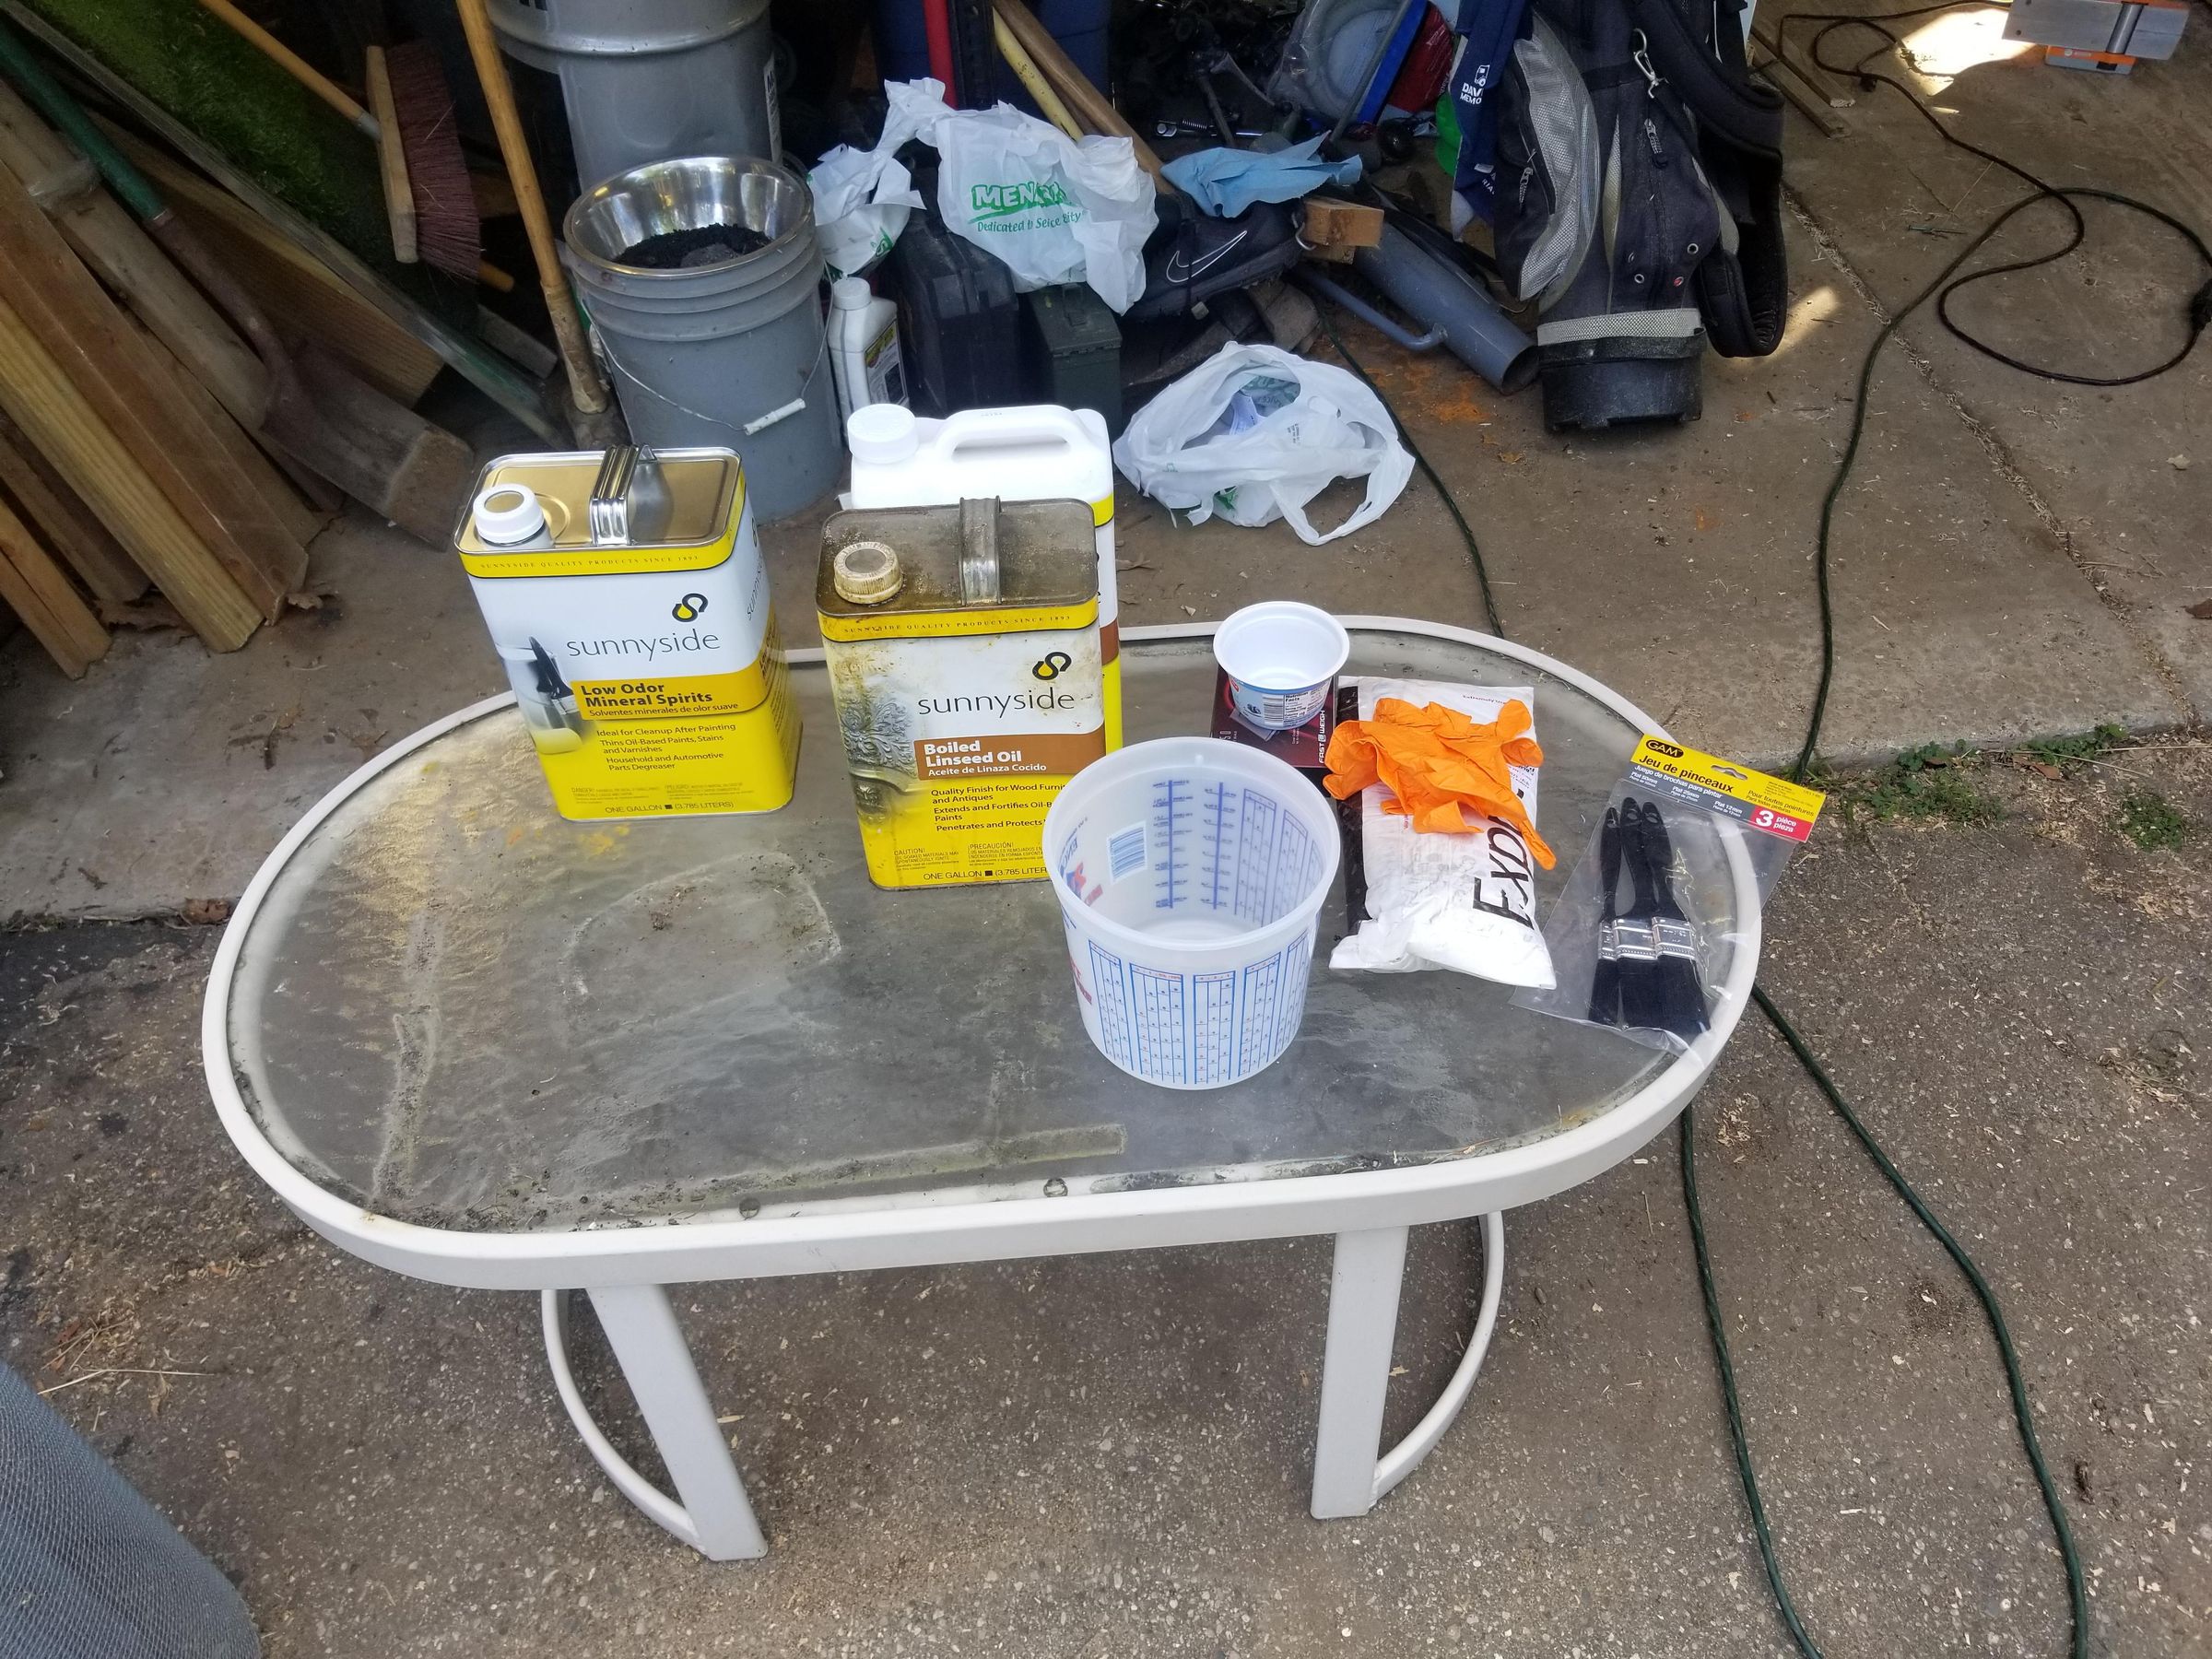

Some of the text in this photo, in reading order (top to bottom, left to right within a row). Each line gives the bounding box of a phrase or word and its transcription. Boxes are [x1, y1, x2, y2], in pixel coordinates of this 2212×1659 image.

[956, 619, 1009, 628] PRODUCTS
[567, 629, 721, 662] sunnyside
[581, 683, 665, 696] Low Odor
[585, 691, 712, 708] Mineral Spirits
[918, 687, 1075, 719] sunnyside
[589, 702, 738, 717] Solventes minerales de olor suave
[635, 727, 673, 736] Cleanup
[675, 725, 697, 734] After
[699, 724, 736, 733] Painting
[625, 737, 666, 746] Oil-Based
[698, 734, 724, 742] Stains
[924, 740, 981, 755] Boiled
[1647, 740, 1679, 757] GAM
[606, 755, 653, 764] Household
[674, 752, 724, 761] Automotive
[925, 750, 1022, 768] Linseed Oil
[632, 763, 676, 772] Degreaser
[928, 763, 1047, 777] Aceite de Linaza Cocido
[1639, 756, 1734, 793] Jeu de pinceaux
[1634, 765, 1653, 776] Juego
[1663, 773, 1688, 787] brochas
[1688, 782, 1703, 793] para
[1702, 788, 1723, 799] pintar
[931, 787, 965, 796] Quality
[967, 785, 994, 794] Finish
[952, 794, 994, 803] Antiques
[1747, 790, 1762, 798] Pour
[1763, 795, 1783, 806] toutes
[934, 806, 971, 815] Extends
[992, 801, 1029, 810] Fortifies
[935, 814, 963, 822] Paints
[936, 823, 984, 832] Penetrates
[1006, 818, 1042, 827] Protects
[1756, 810, 1774, 827] 3
[924, 872, 944, 880] ONE
[945, 870, 982, 879] GALLON
[994, 868, 1020, 877] (3.785
